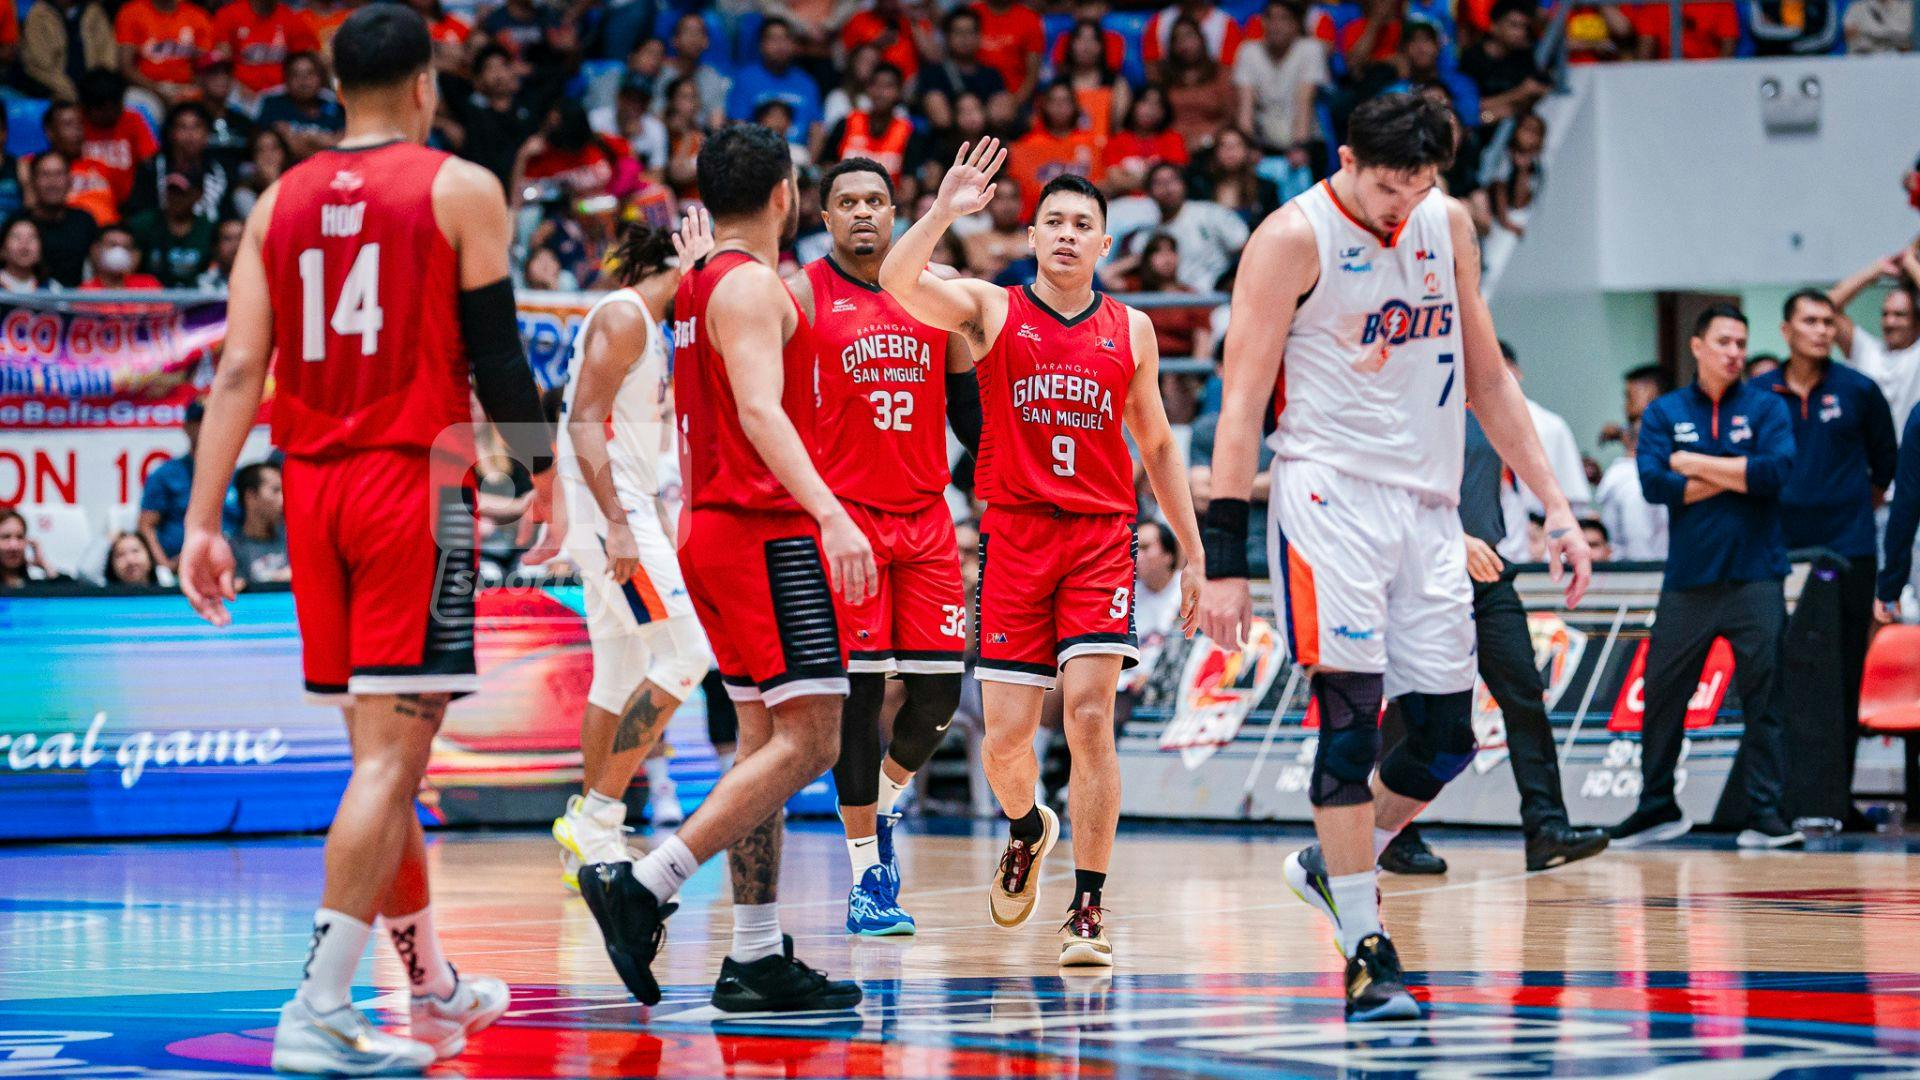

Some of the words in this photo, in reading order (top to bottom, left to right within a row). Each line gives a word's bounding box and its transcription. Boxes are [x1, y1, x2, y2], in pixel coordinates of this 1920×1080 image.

[299, 242, 383, 361] 14
[1361, 300, 1453, 345] BOLTS
[0, 310, 63, 355] CO
[856, 323, 914, 336] BARANGAY
[841, 334, 931, 374] GINEBRA
[1035, 362, 1098, 377] BARANGAY
[853, 368, 880, 384] SAN
[883, 367, 926, 383] MIGUEL
[1438, 353, 1455, 407] 7
[869, 390, 914, 432] 32
[1013, 374, 1113, 421] GINEBRA
[1022, 406, 1051, 425] SAN
[1056, 411, 1104, 431] MIGUEL
[1051, 435, 1076, 477] 9
[940, 604, 966, 638] 32
[1109, 587, 1130, 619] 9
[116, 727, 288, 789] game
